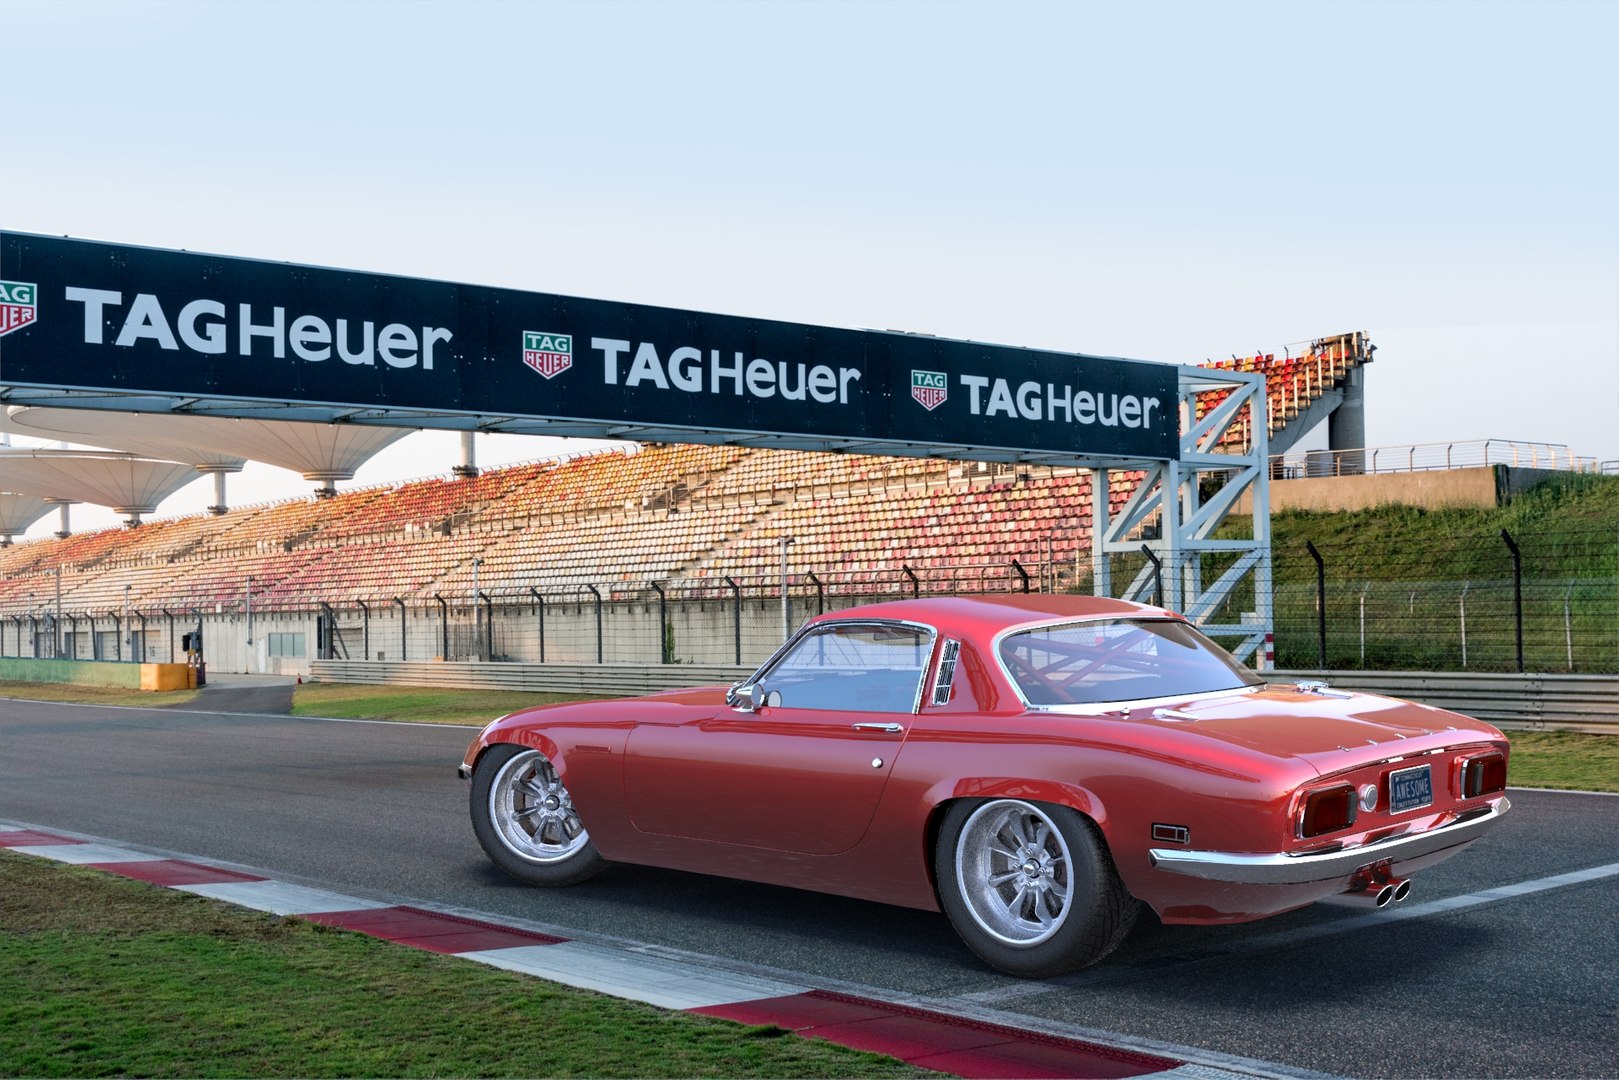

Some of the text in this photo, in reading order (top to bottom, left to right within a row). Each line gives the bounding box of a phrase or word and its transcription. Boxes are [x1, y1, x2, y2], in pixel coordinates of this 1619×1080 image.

[0, 284, 30, 303] AG
[0, 306, 32, 331] UER
[527, 334, 568, 352] TAG
[526, 352, 570, 376] HEUER
[914, 373, 944, 387] TAG
[914, 388, 945, 408] HEUER
[1396, 778, 1430, 800] AWESOME
